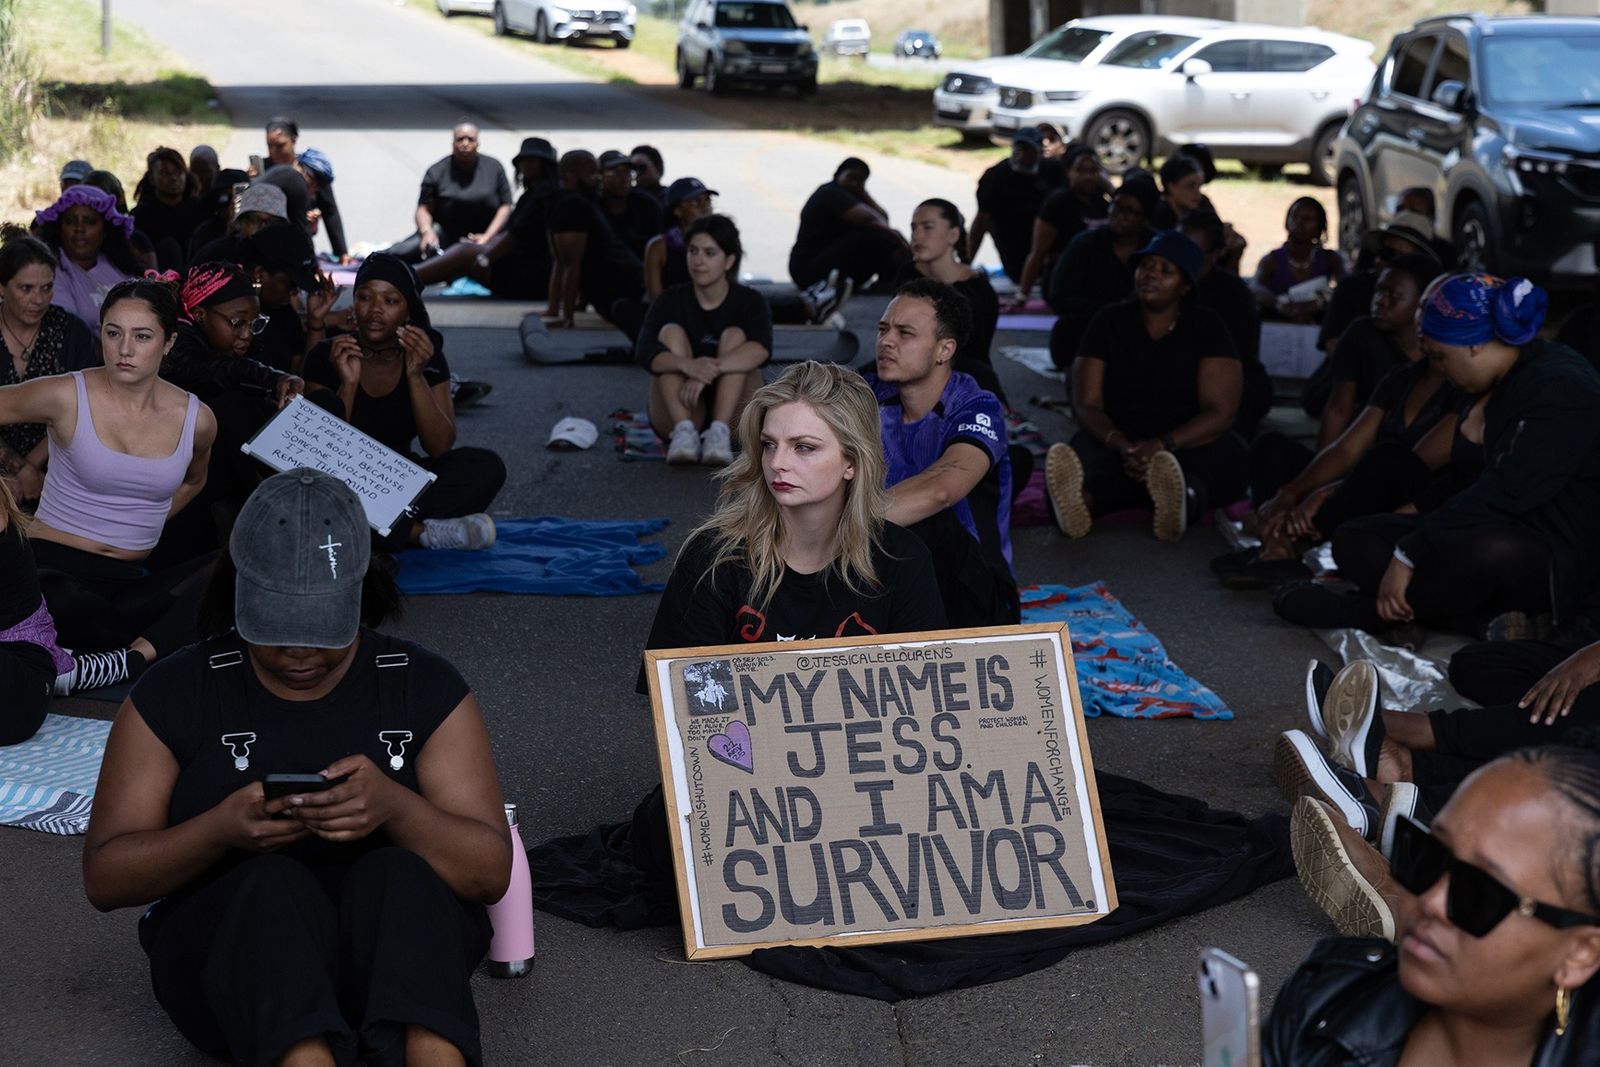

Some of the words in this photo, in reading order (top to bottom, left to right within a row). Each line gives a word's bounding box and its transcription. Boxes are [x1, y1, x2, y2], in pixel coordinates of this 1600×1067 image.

[281, 430, 332, 461] SOMEONE
[337, 459, 391, 495] VIOLATED
[292, 410, 313, 424] IT
[316, 425, 352, 447] FEELS
[359, 447, 374, 460] TO
[377, 460, 408, 480] HATE
[293, 422, 320, 442] YOUR
[325, 442, 353, 460] BODY
[358, 461, 405, 492] BECAUSE
[299, 401, 318, 416] YOU
[321, 415, 356, 437] DON'T
[359, 437, 389, 457] KNOW
[394, 459, 418, 476] HOW
[314, 457, 340, 475] THE
[344, 478, 378, 500] MIND
[740, 669, 828, 726] MY
[837, 661, 971, 719] NAME
[975, 654, 1015, 712] IS
[796, 647, 953, 671] @JESSICALEELOURENS
[978, 717, 1004, 725] PROTECT
[1004, 715, 1028, 723] WOMEN
[725, 786, 822, 848] AND
[854, 780, 903, 837] I
[927, 769, 1014, 832] AM
[1021, 761, 1064, 824] A
[722, 824, 1096, 934] SURVIVOR.
